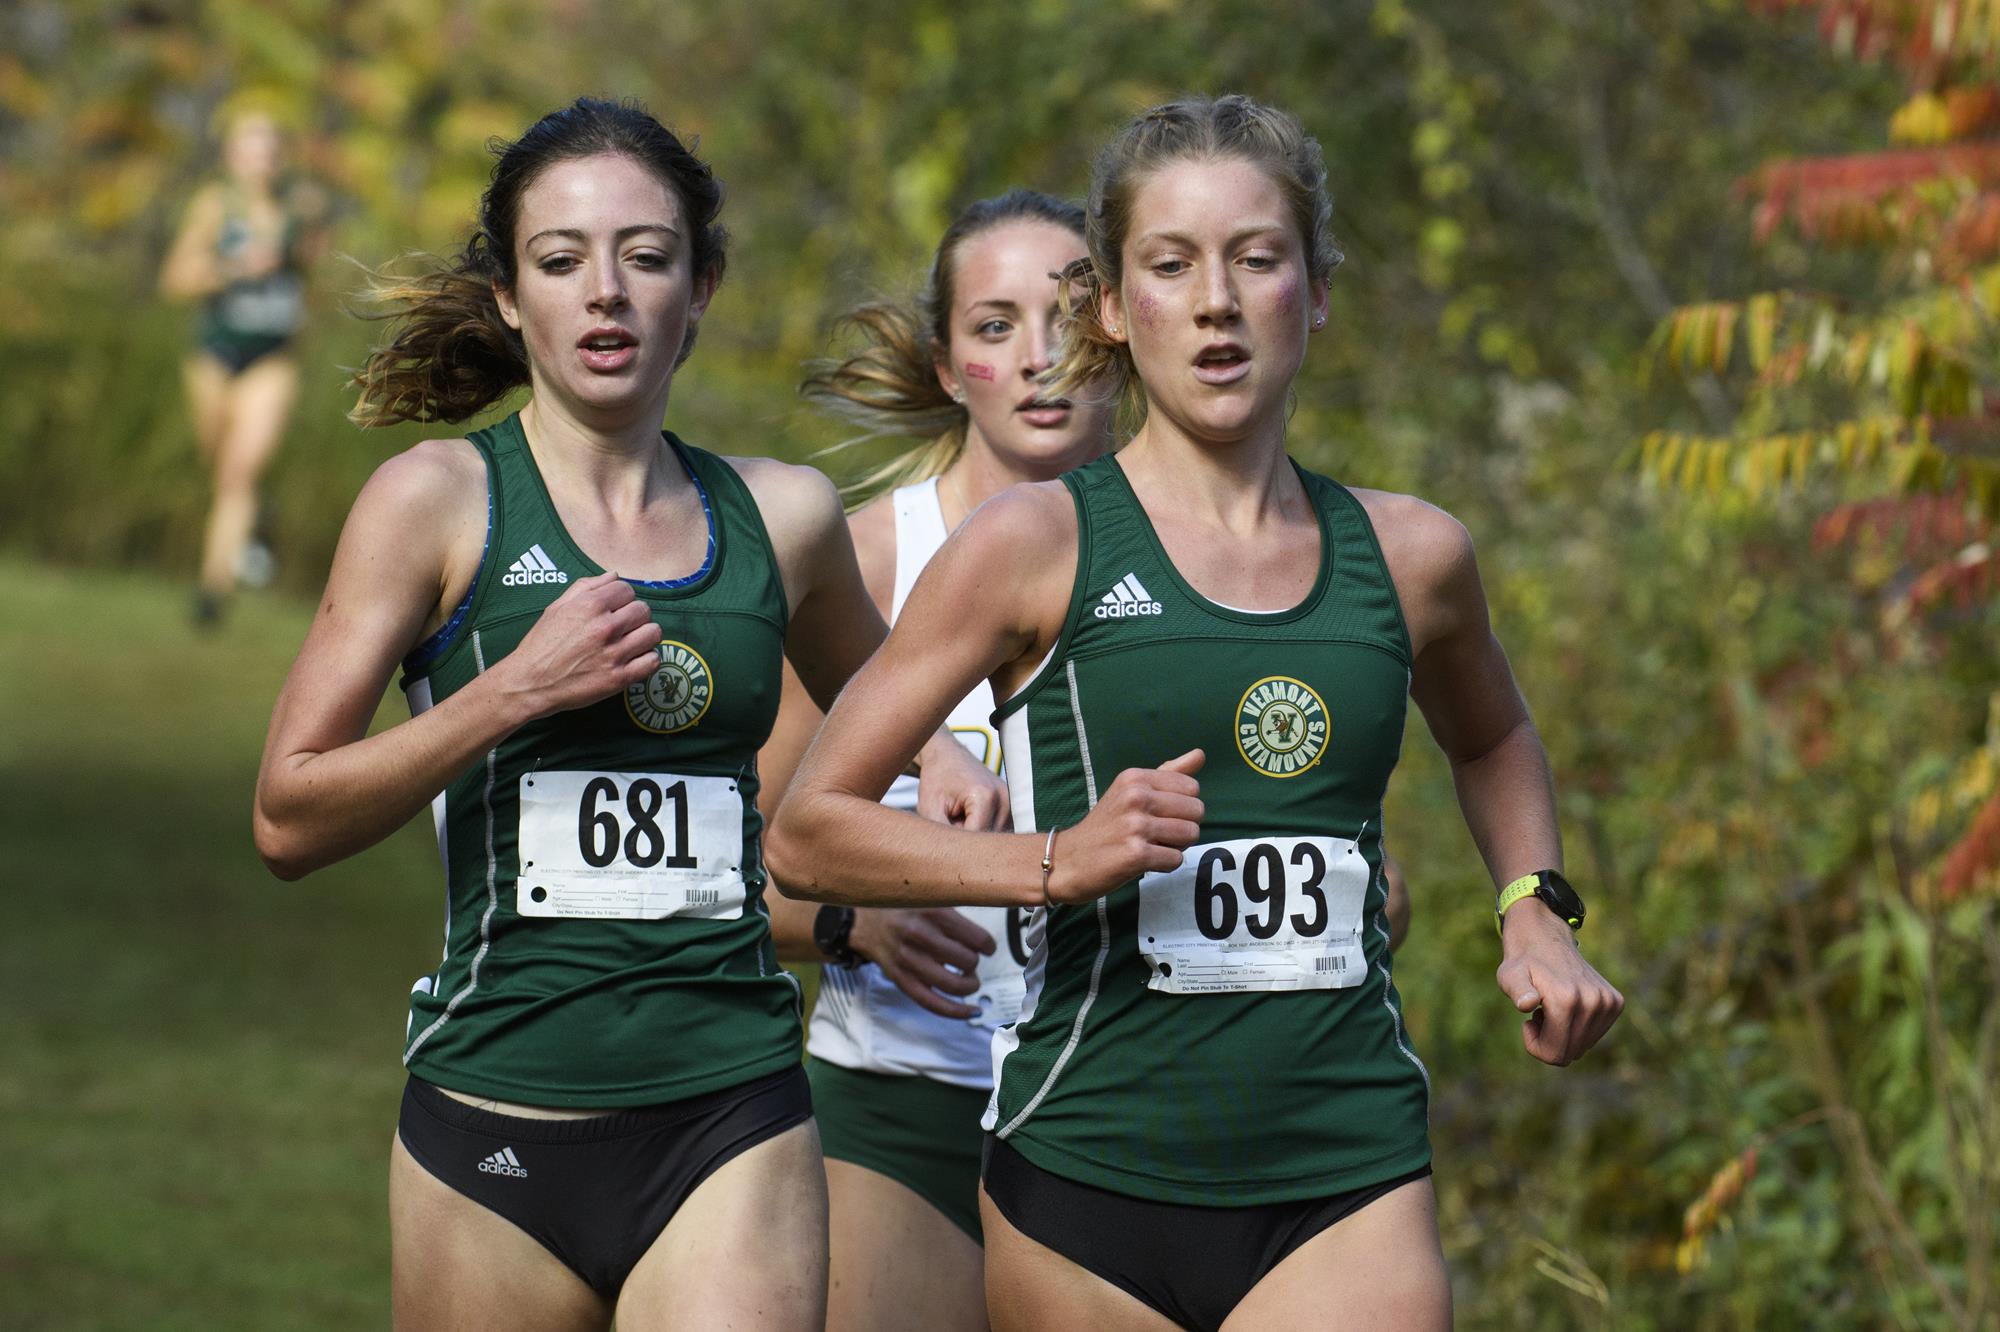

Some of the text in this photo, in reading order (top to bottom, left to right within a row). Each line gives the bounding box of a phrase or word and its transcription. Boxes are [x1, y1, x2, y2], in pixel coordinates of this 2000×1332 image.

[502, 569, 568, 586] adidas
[1094, 600, 1163, 618] adidas
[629, 683, 708, 729] CATAMOUNTS
[1242, 681, 1321, 717] VERMONT
[1240, 721, 1325, 773] CATAMOUNTS
[578, 776, 698, 868] 681
[1194, 842, 1328, 940] 693
[478, 1162, 528, 1178] adidas
